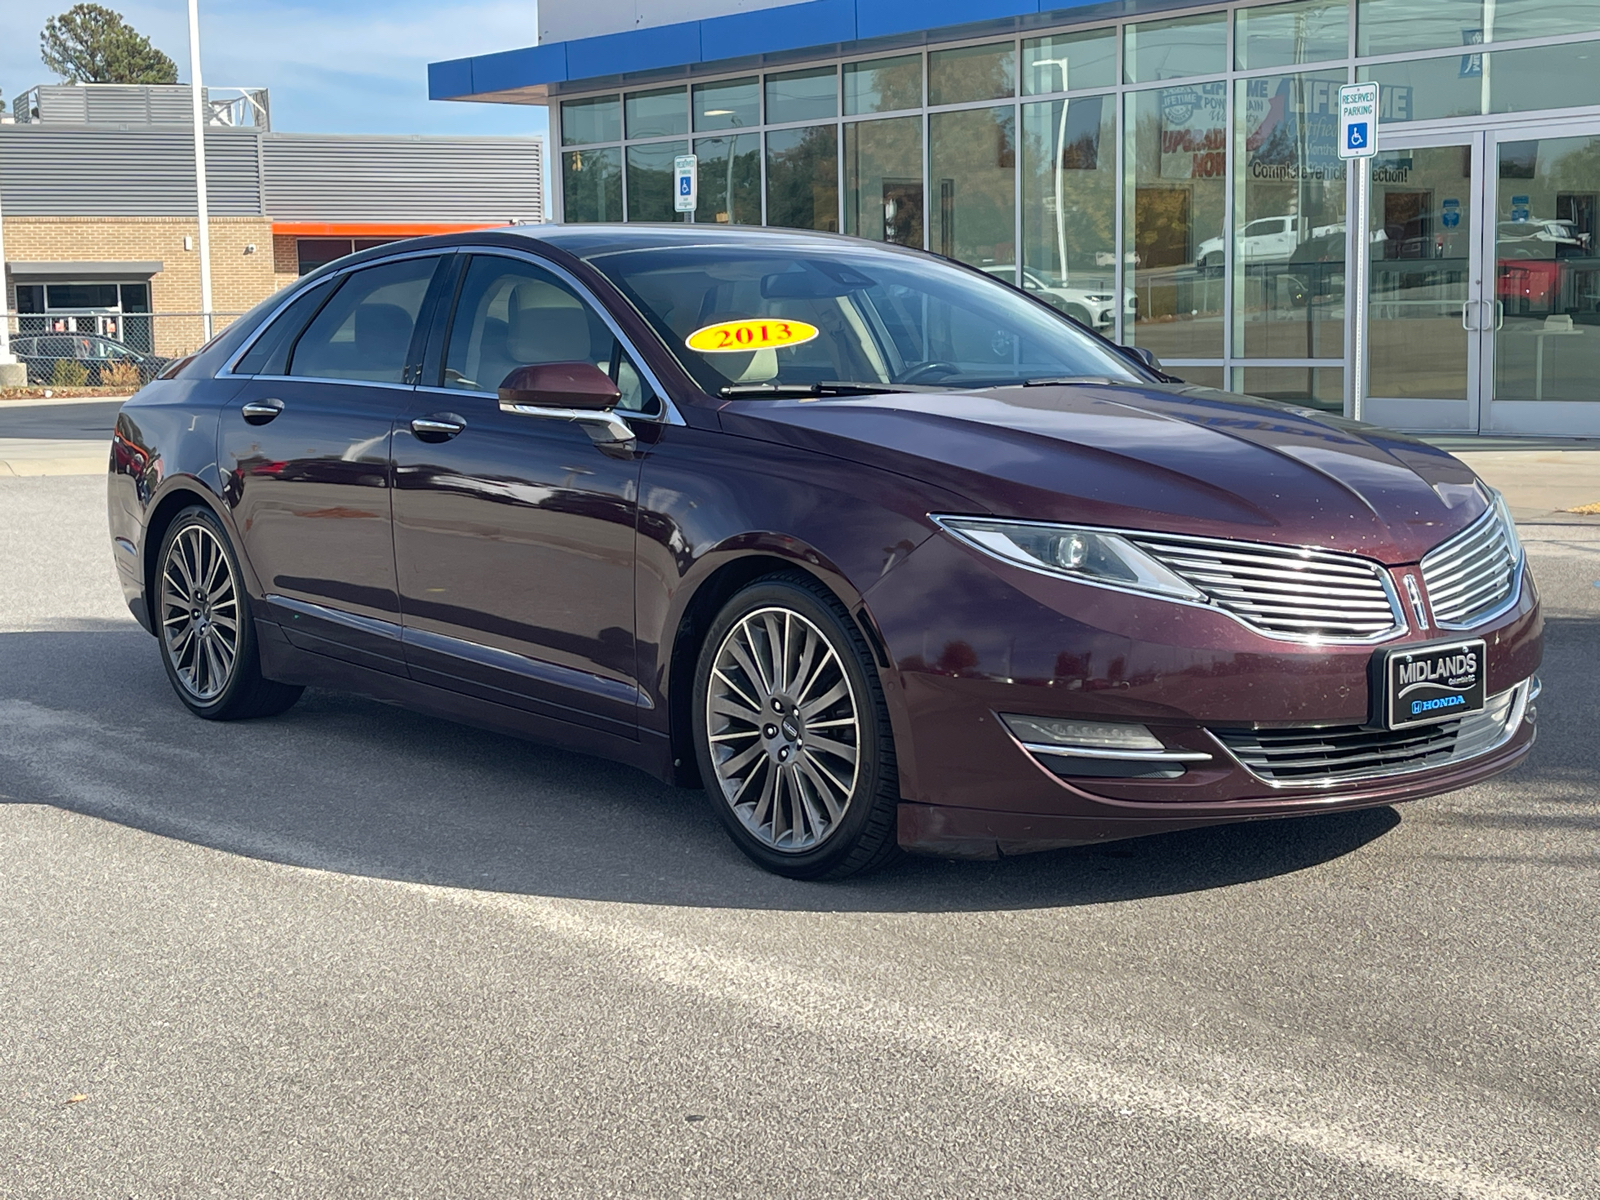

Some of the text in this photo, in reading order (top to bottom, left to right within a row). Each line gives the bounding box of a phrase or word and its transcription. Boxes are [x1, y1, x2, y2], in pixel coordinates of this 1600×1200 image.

[1289, 80, 1407, 119] LIFEME
[1342, 92, 1375, 104] RESERVED
[1343, 104, 1373, 116] PARKING
[1253, 161, 1307, 181] Complete
[1372, 166, 1408, 182] ection!
[715, 323, 792, 348] 2013
[1400, 653, 1477, 684] MIDLANDS
[1422, 695, 1465, 711] HONDA
